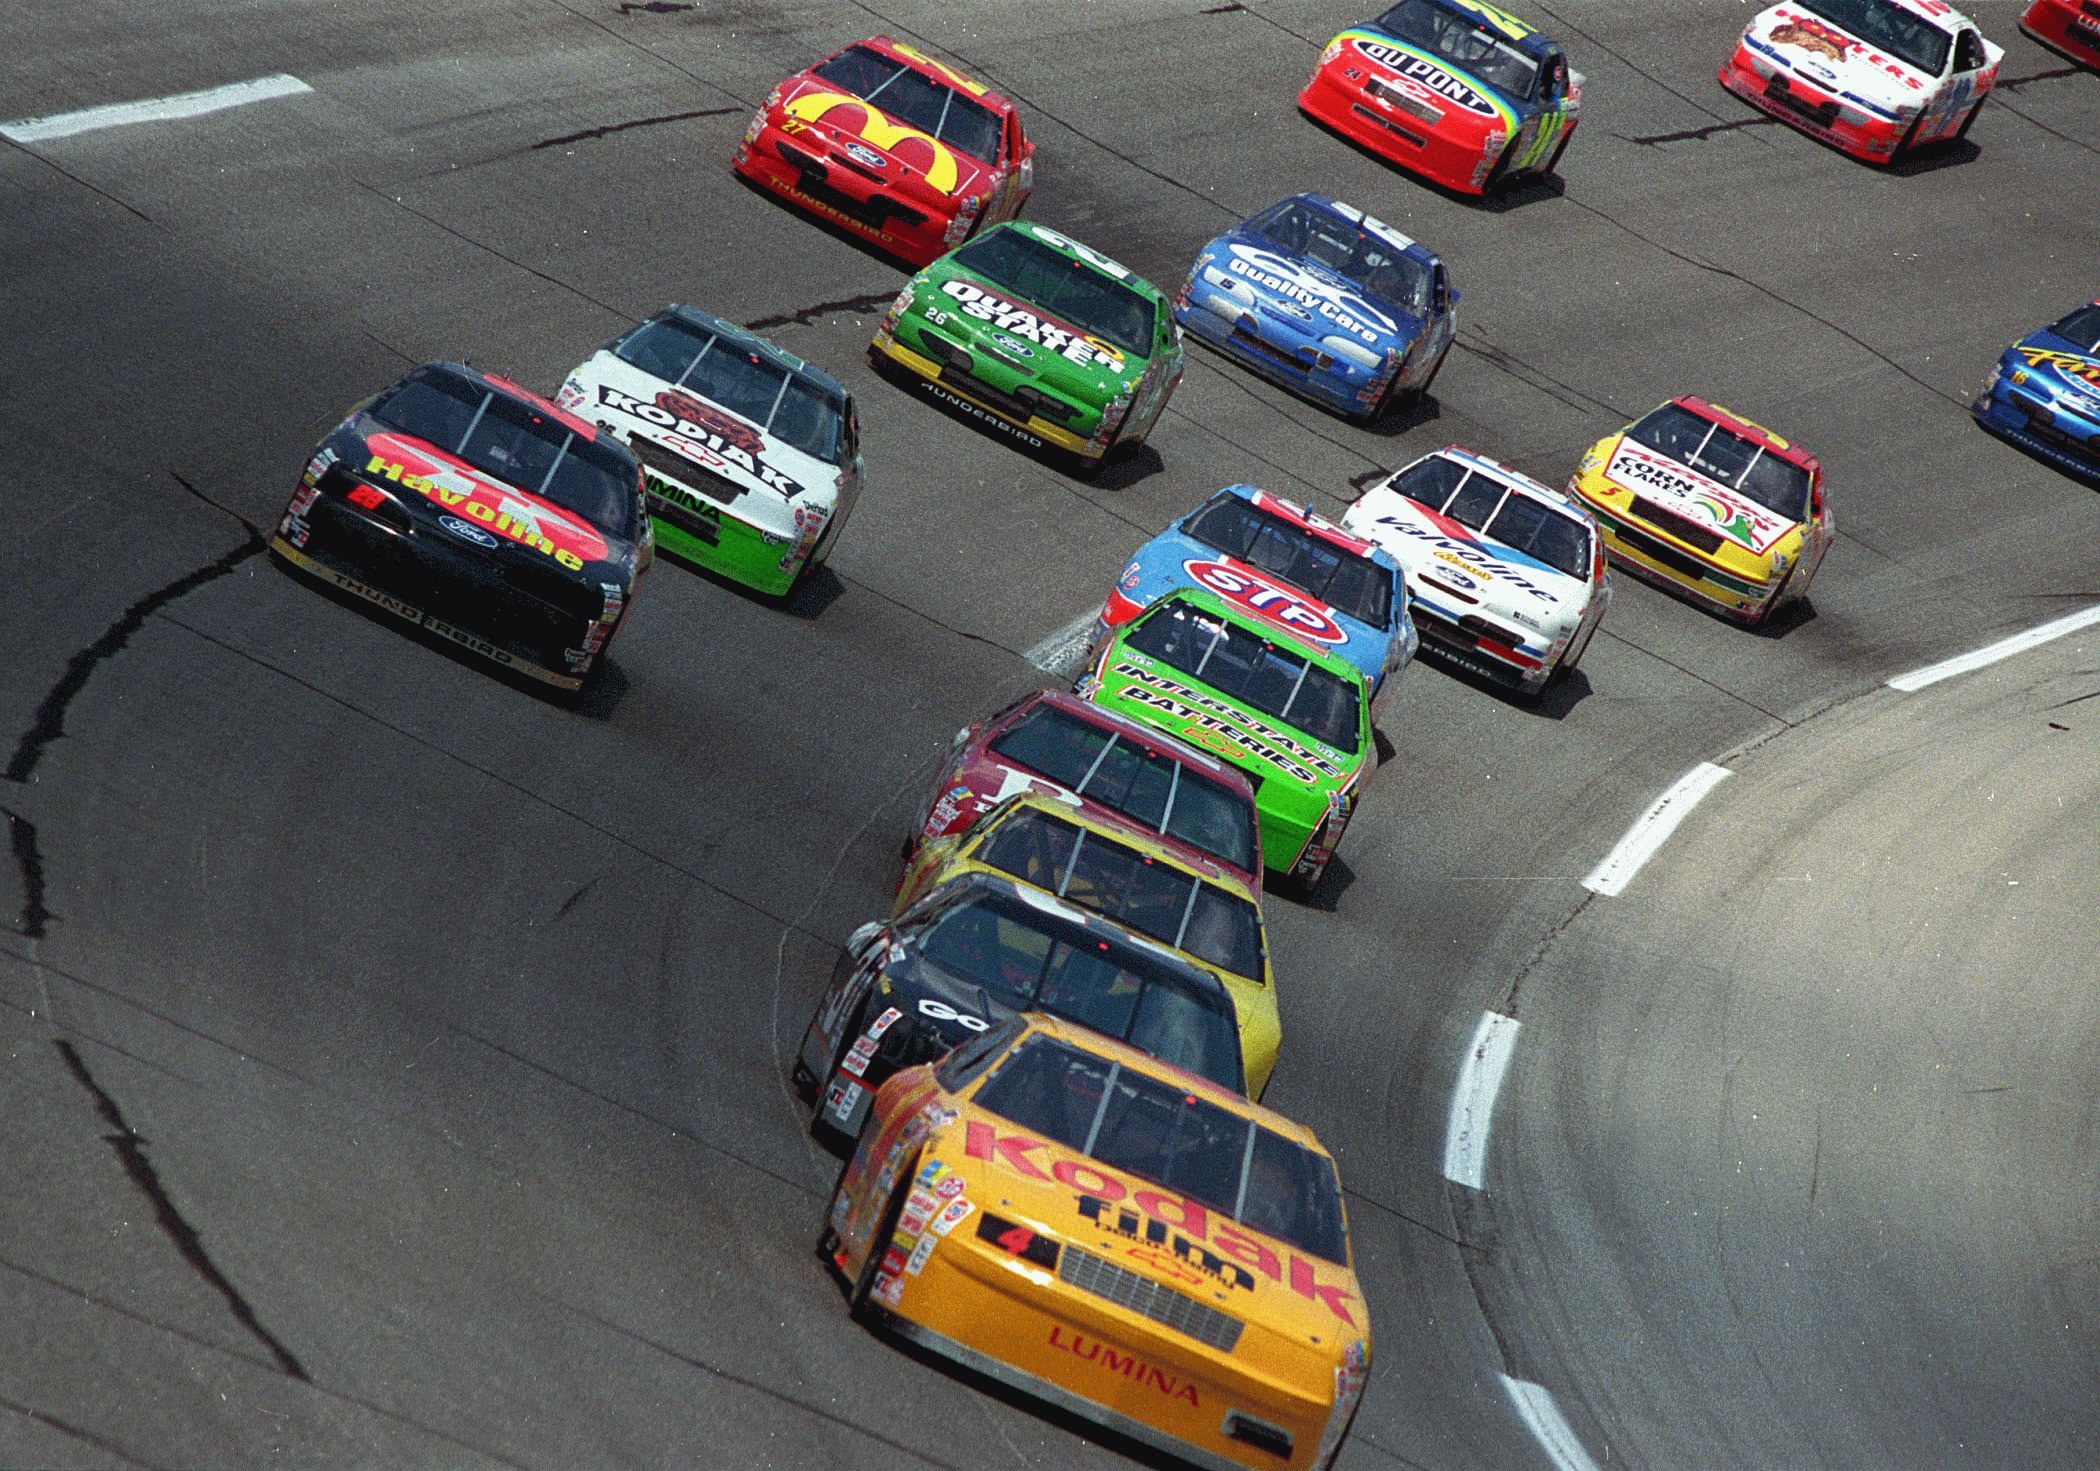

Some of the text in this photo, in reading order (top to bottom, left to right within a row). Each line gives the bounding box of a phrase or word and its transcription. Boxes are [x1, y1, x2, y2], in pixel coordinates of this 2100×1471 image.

[1343, 66, 1362, 80] 24
[1405, 60, 1487, 113] PONT
[780, 119, 807, 136] 27
[770, 175, 893, 243] THUNDERBIRD
[924, 306, 948, 325] 26
[1220, 278, 1236, 290] 15
[942, 280, 1124, 374] QUAKER
[961, 302, 1087, 366] STATE
[602, 390, 797, 492] KODIAK
[1600, 487, 1622, 496] 5
[1612, 462, 1686, 498] FLAKES
[1619, 456, 1695, 493] CORN
[366, 455, 584, 572] Havoline
[446, 518, 491, 546] Ford
[1375, 515, 1559, 603] Valvoline
[1202, 567, 1328, 630] STP
[1112, 664, 1341, 779] INTERSTATE
[1121, 686, 1317, 784] BATTERIES
[965, 1119, 1357, 1330] Kodak
[997, 1226, 1034, 1256] 4
[1073, 1194, 1255, 1292] film
[1048, 1326, 1201, 1408] LUMINA
